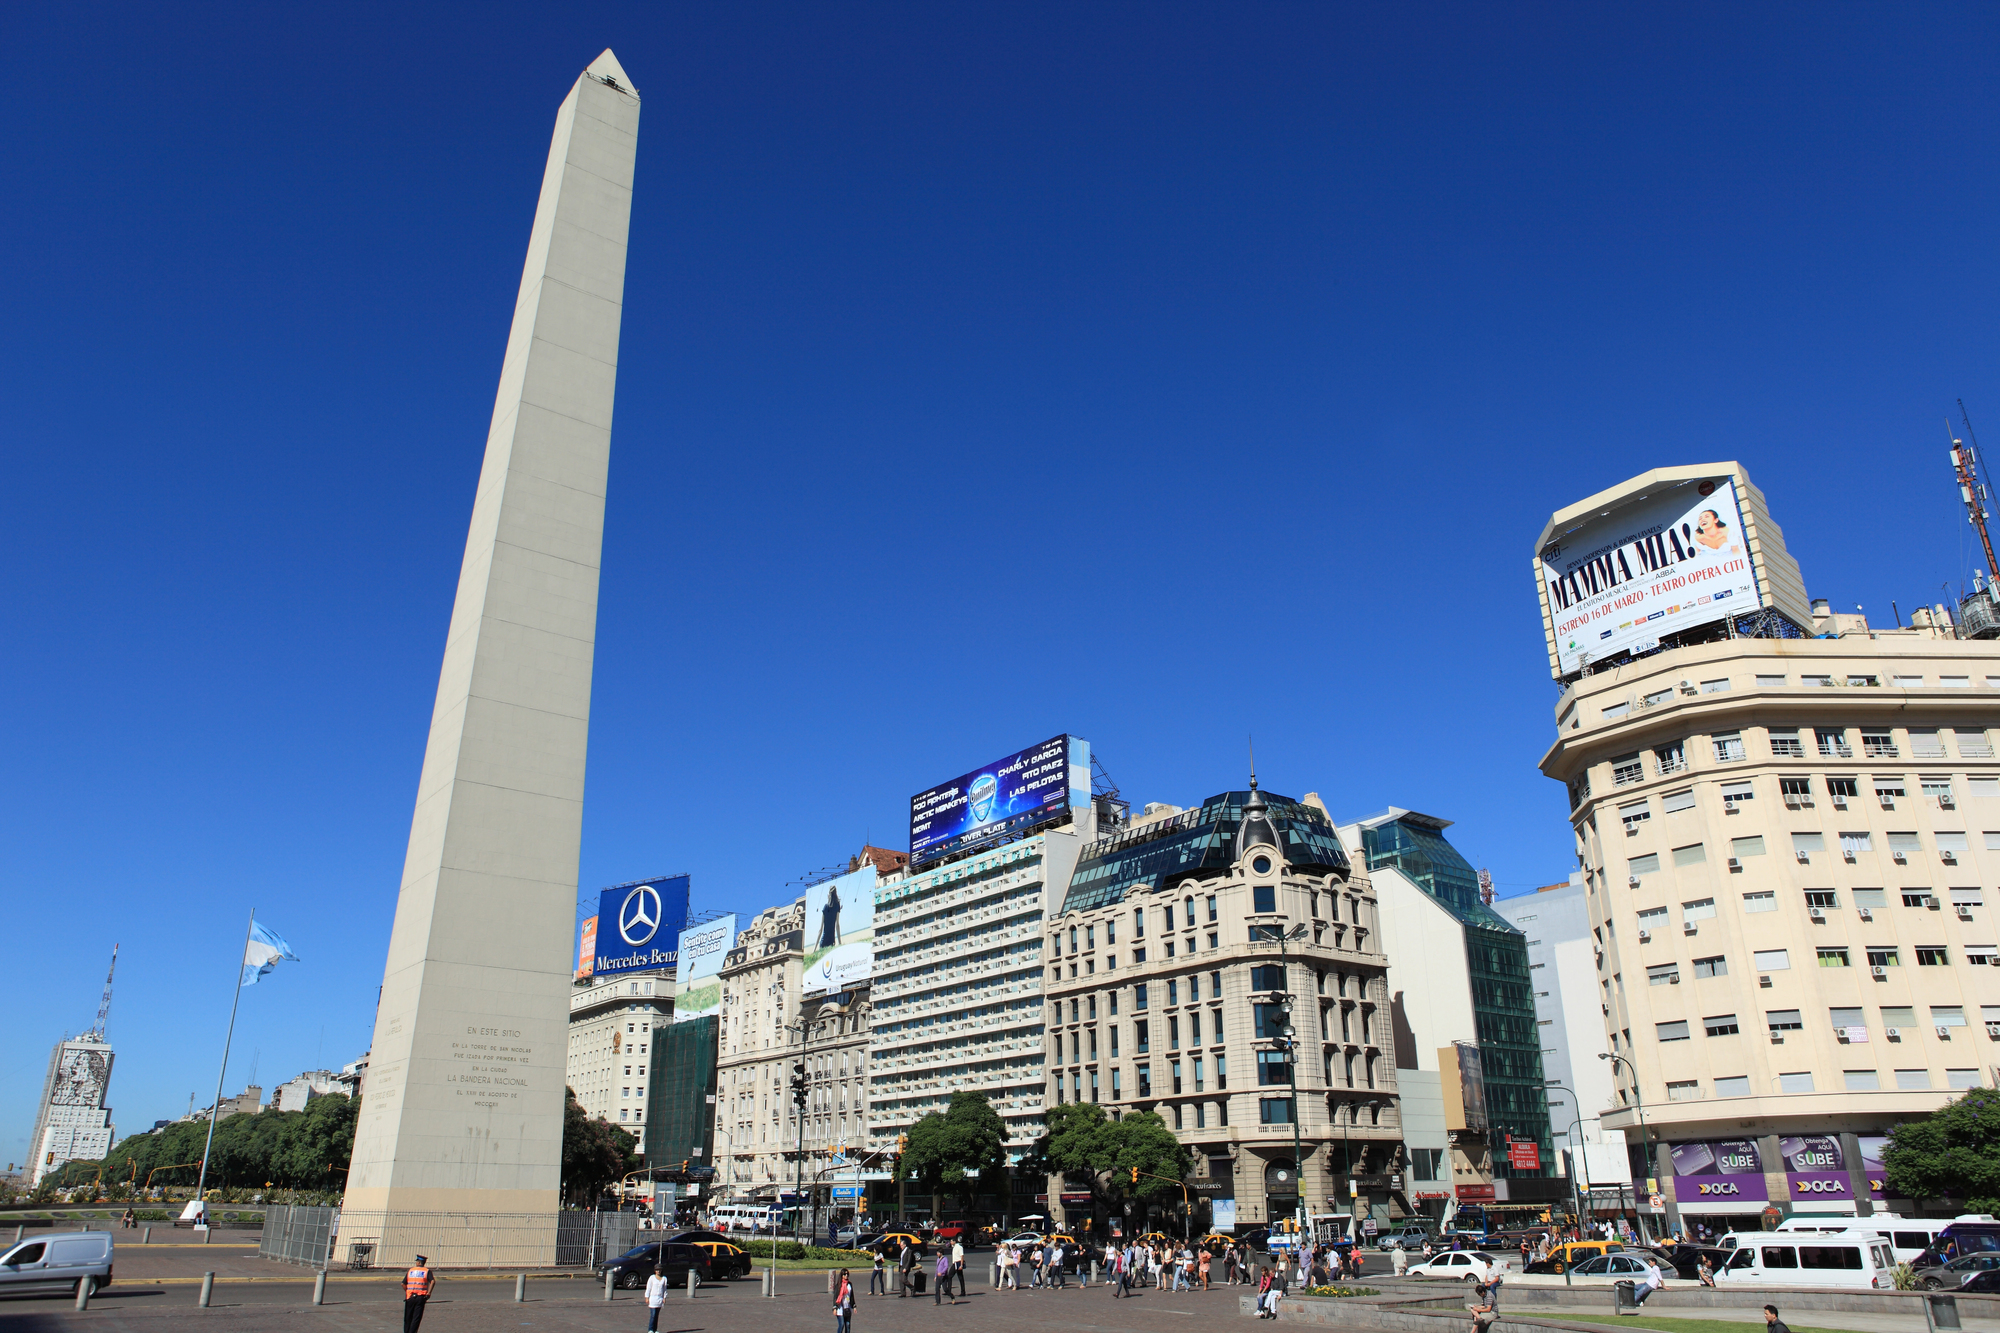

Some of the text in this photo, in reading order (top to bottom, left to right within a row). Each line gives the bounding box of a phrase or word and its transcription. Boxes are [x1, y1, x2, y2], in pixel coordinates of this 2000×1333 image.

[1545, 546, 1561, 562] citi
[1566, 558, 1582, 570] BENNY
[1582, 544, 1613, 562] ANDERSSON
[1612, 541, 1618, 549] &
[1551, 522, 1696, 614] MAMMA MIA!
[1655, 567, 1676, 580] ABBA
[1558, 612, 1590, 636] ESTRENO
[1591, 608, 1601, 620] 16
[1601, 602, 1613, 616] DE
[1613, 590, 1644, 611] MARZO
[1650, 575, 1686, 596] TEATRO
[1688, 565, 1722, 584] OPERA
[1723, 558, 1744, 574] CITI
[1583, 594, 1605, 609] EXITOSO
[1605, 585, 1629, 600] MUSICAL
[1562, 644, 1585, 658] LAS PALMAS
[1641, 640, 1656, 651] CBS
[998, 746, 1063, 777] CHARLY GARCIA
[1022, 758, 1064, 780] FITO PAEZ
[1009, 786, 1026, 798] LAS
[1027, 772, 1064, 791] PELOTAS
[913, 801, 926, 811] FOO
[913, 795, 968, 823] ARCTIC MONKEYS
[912, 821, 931, 835] MGMT
[684, 926, 727, 950] Sentite como
[688, 940, 721, 959] en tu casa
[596, 948, 678, 972] Mercedes-Benz
[836, 962, 853, 972] Uruguay
[467, 1026, 521, 1038] EN ESTE SITIO
[447, 1074, 528, 1087] LA BANDERA NACIONAL
[1672, 1149, 1684, 1159] SUBE
[1721, 1154, 1755, 1168] SUBE
[1796, 1151, 1835, 1166] SUBE
[1711, 1182, 1739, 1194] OCA
[1812, 1180, 1845, 1192] OCA
[1421, 1191, 1443, 1199] Santander
